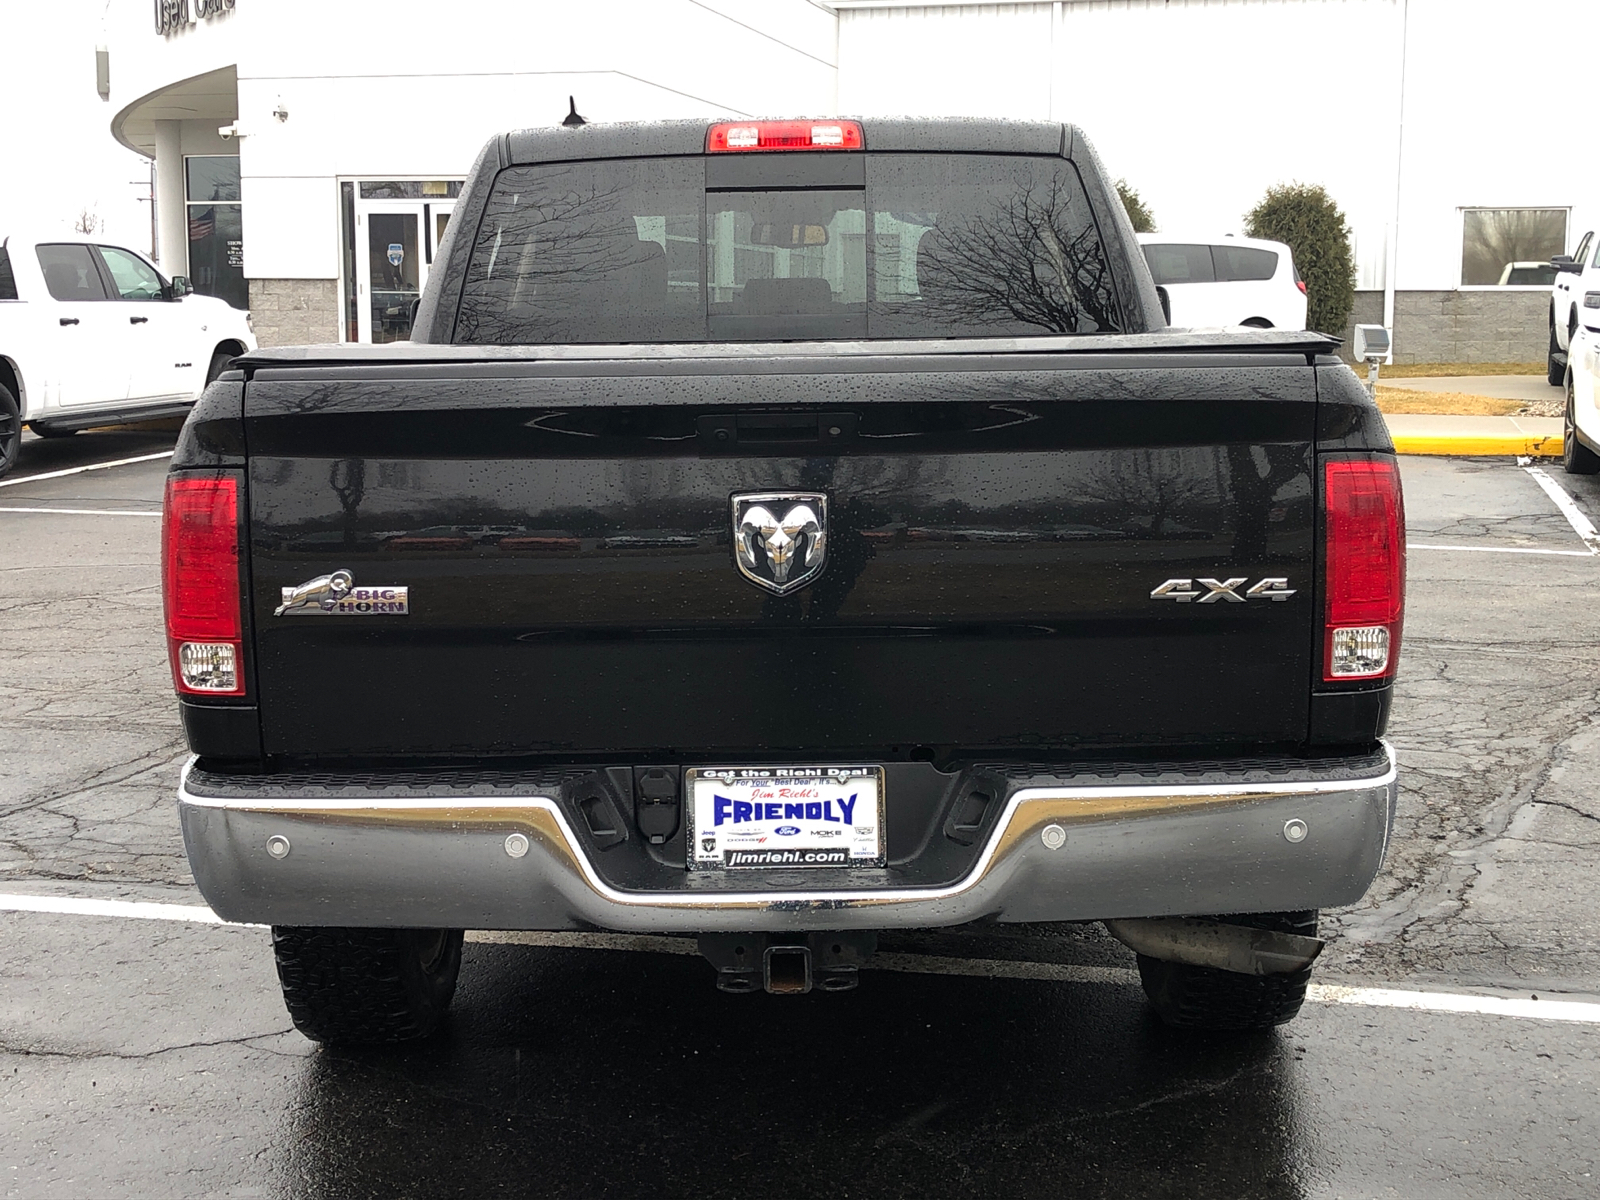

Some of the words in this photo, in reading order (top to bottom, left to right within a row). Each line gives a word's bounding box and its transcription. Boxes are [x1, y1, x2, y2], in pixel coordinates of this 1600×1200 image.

[154, 0, 189, 35] Used
[356, 590, 396, 601] BIG
[1150, 577, 1297, 603] 4X4
[339, 602, 404, 612] HORN
[703, 770, 736, 778] Get
[740, 770, 771, 778] the
[776, 769, 821, 777] Riehl
[827, 768, 868, 776] Deal
[750, 779, 771, 787] Your
[750, 788, 775, 802] Jim
[778, 788, 819, 799] Riehl's
[713, 791, 859, 828] FRIENDLY
[728, 851, 846, 867] jimriehl.com
